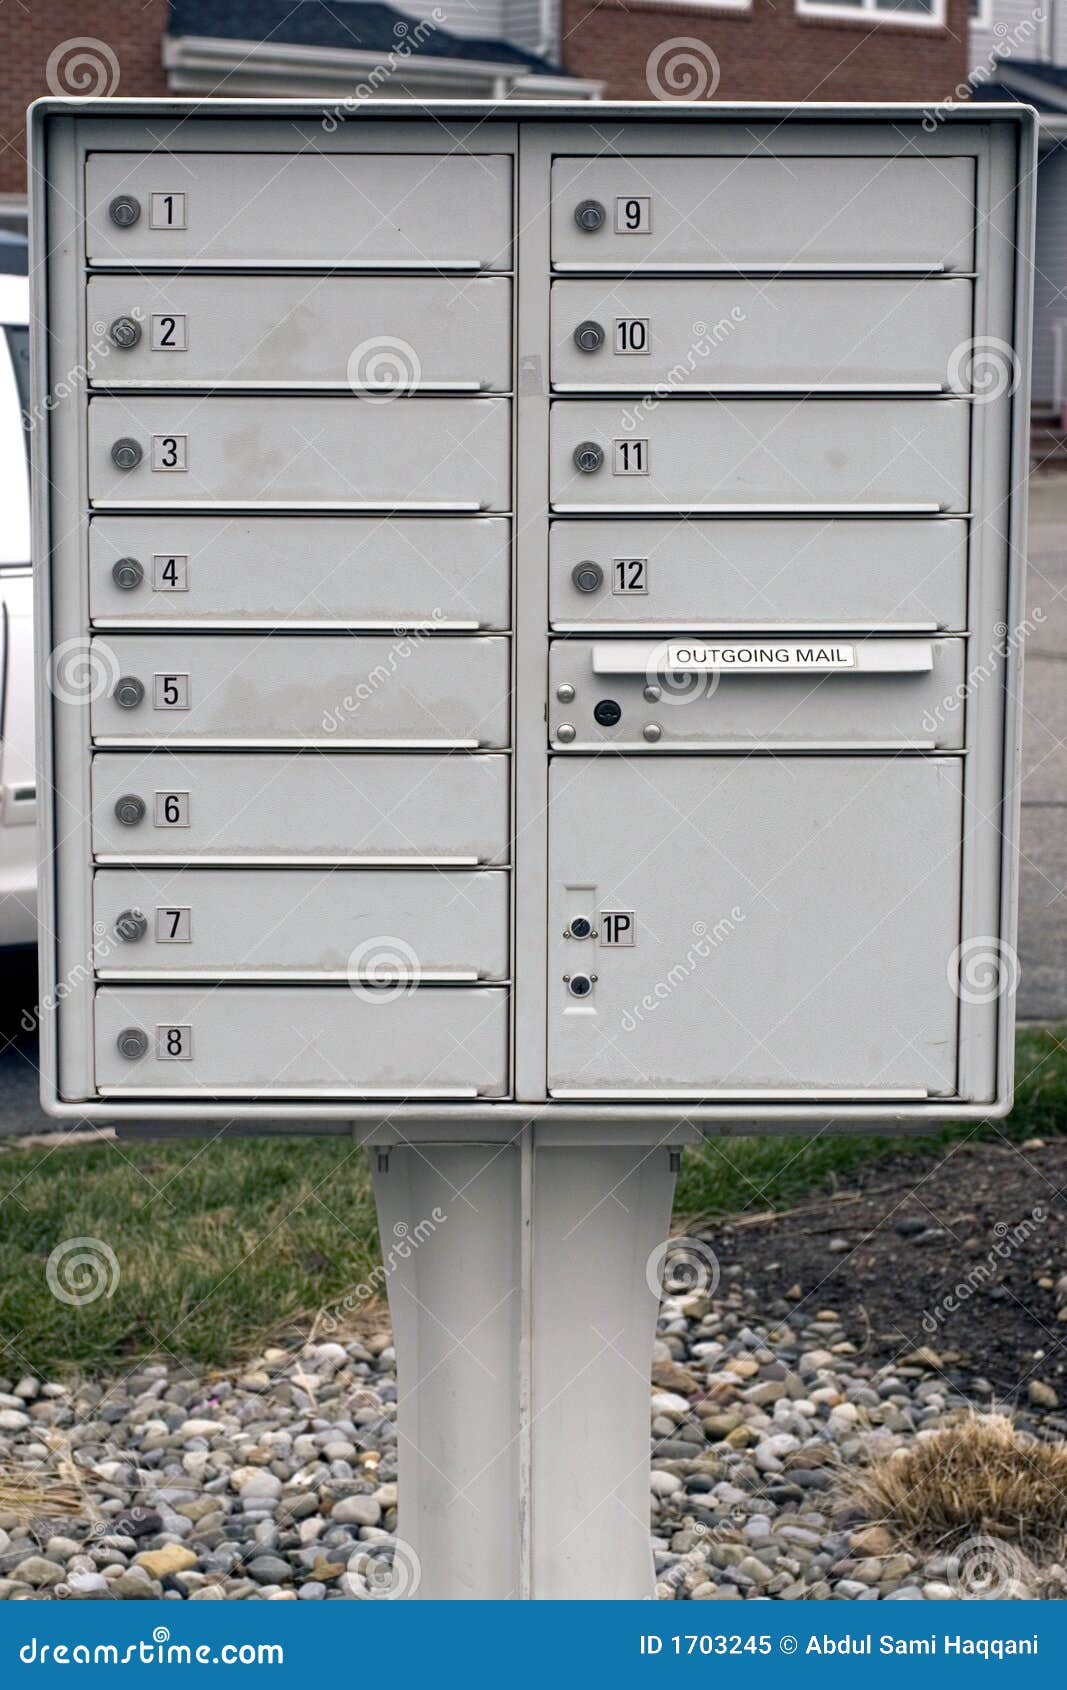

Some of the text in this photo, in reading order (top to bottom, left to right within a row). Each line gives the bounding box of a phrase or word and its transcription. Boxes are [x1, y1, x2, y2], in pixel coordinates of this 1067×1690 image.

[163, 197, 173, 225] 1
[625, 201, 641, 230] 9
[160, 318, 176, 346] 2
[617, 321, 646, 350] 10
[161, 438, 178, 467] 3
[619, 443, 643, 471] 11
[162, 559, 178, 587] 4
[615, 562, 644, 590] 12
[676, 648, 848, 663] OUTGOING MAIL
[163, 677, 179, 705] 5
[164, 797, 180, 824] 6
[165, 911, 181, 939] 7
[603, 915, 631, 943] 1P
[166, 1029, 182, 1056] 8
